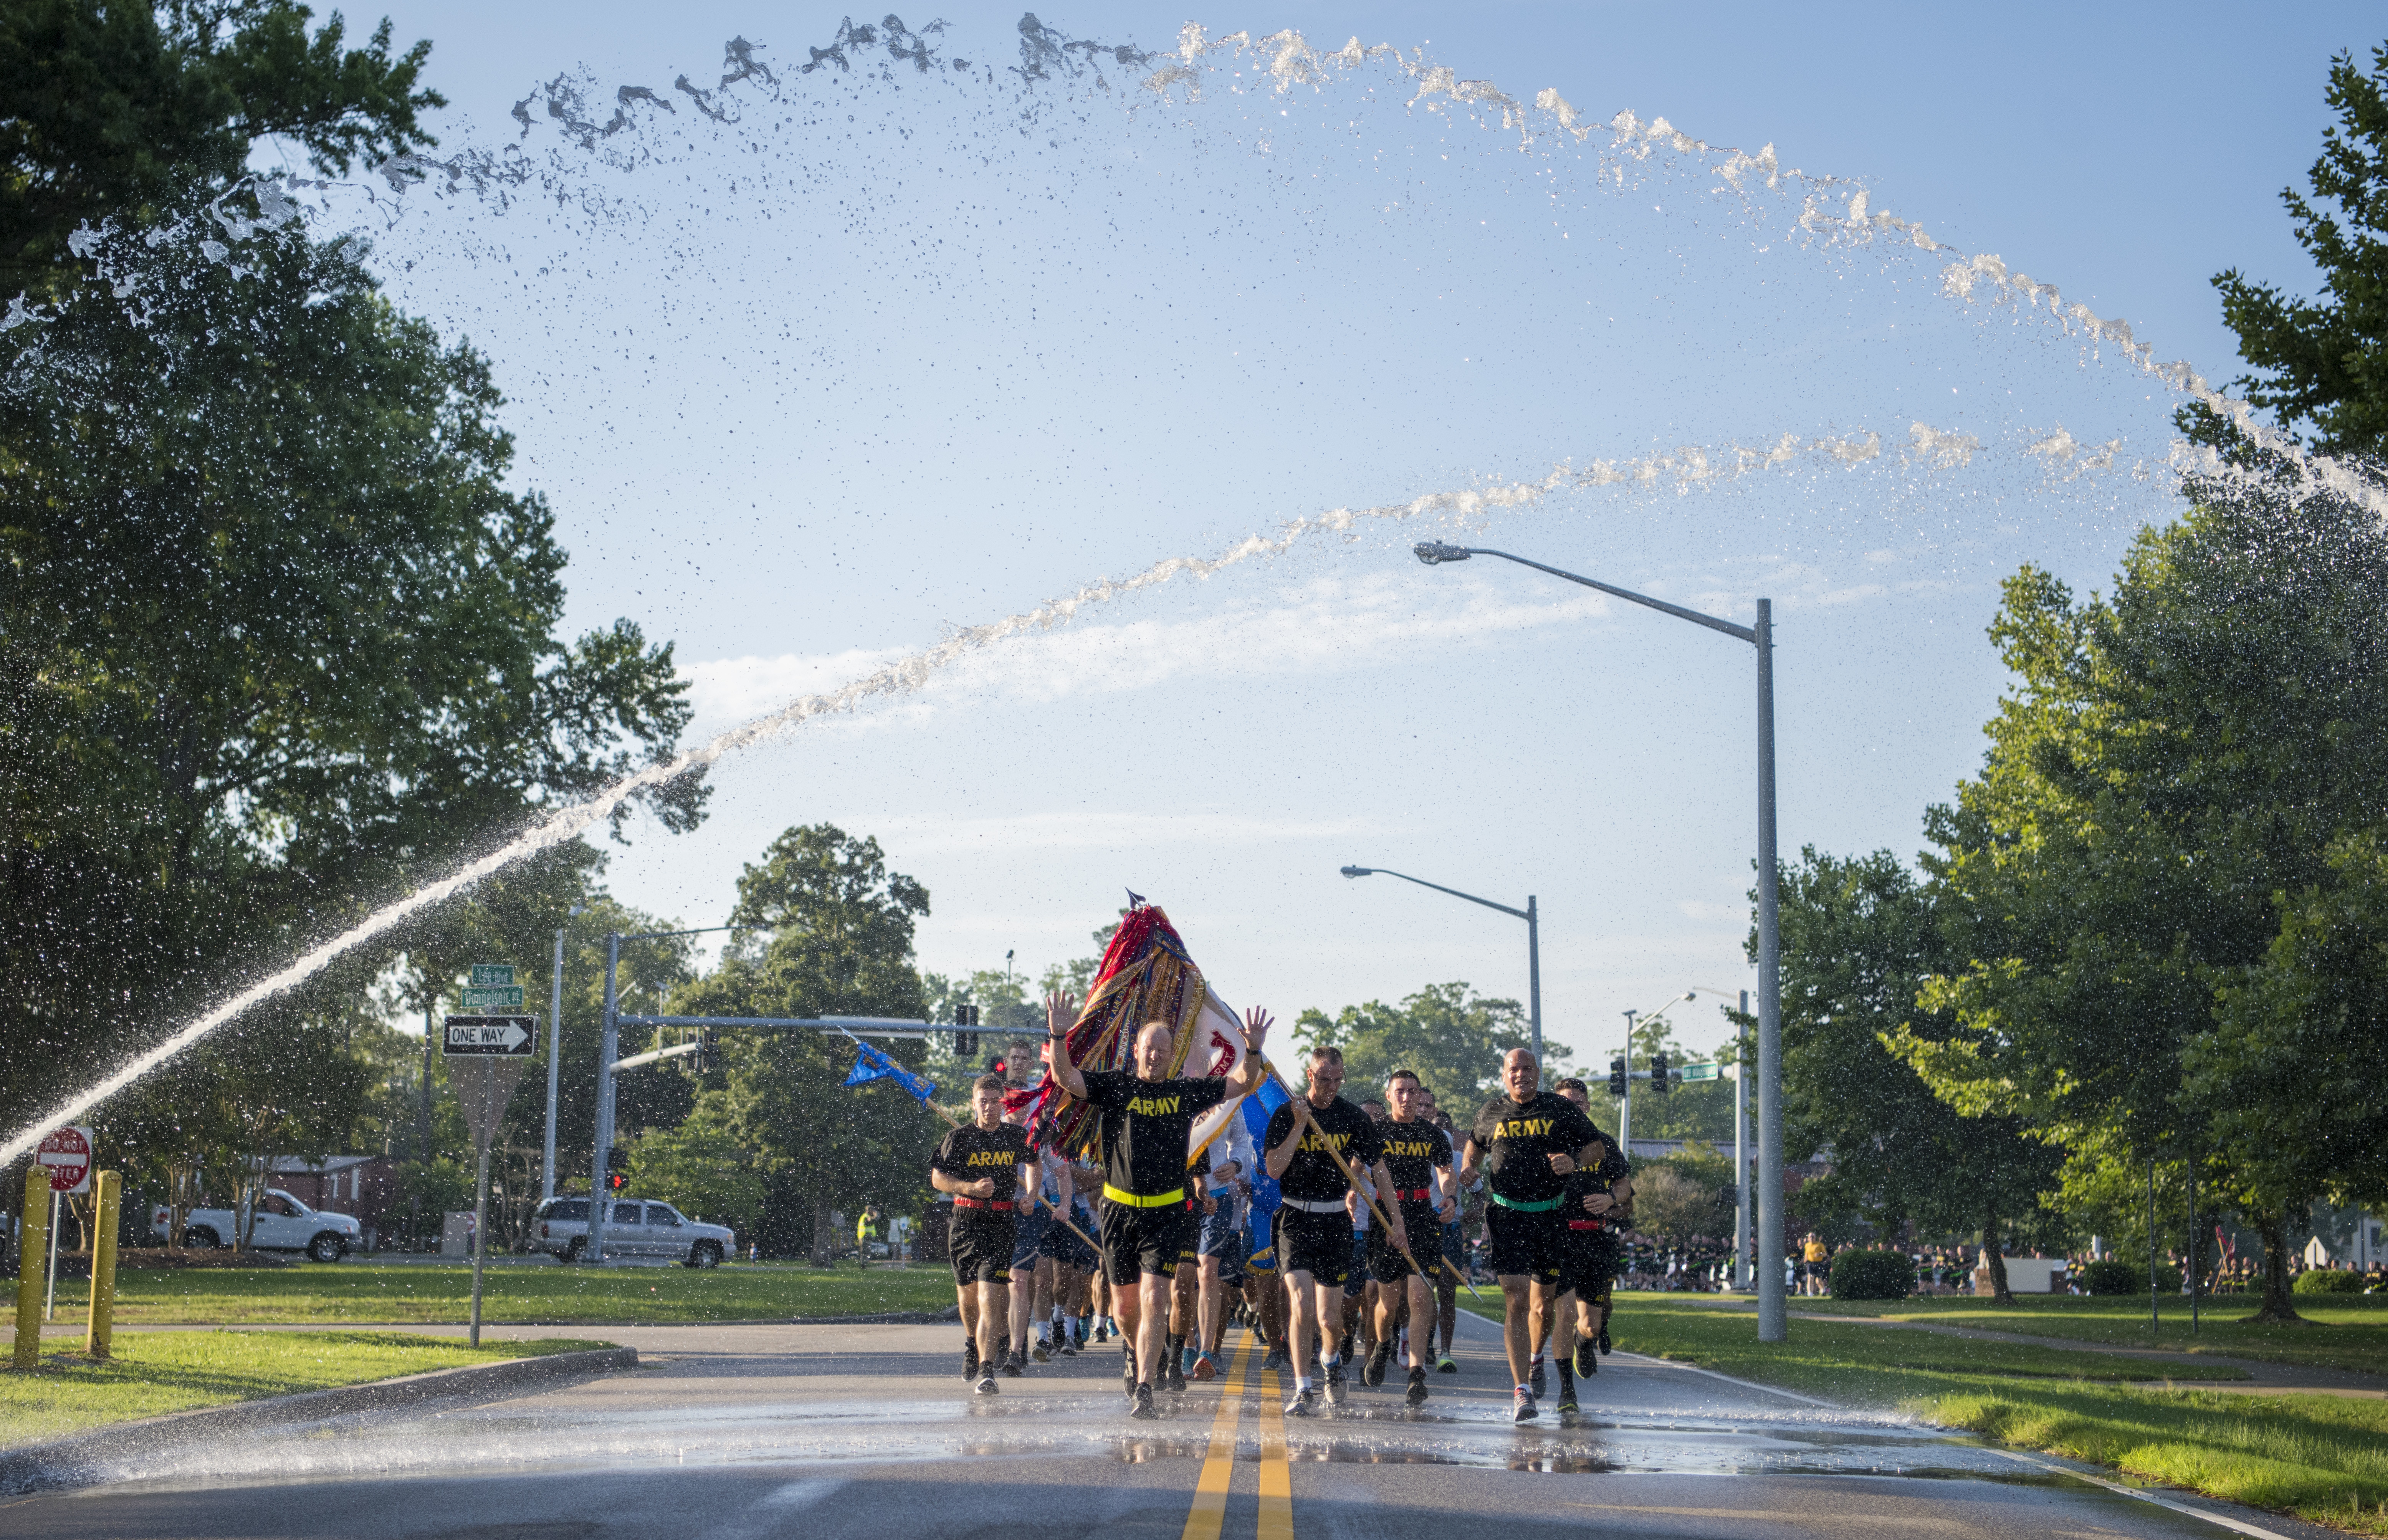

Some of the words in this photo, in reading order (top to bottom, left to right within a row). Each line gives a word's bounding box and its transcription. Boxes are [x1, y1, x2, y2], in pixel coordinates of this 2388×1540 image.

[452, 1028, 476, 1043] ONE
[481, 1028, 506, 1043] WAY
[1214, 1051, 1233, 1076] RMY
[1126, 1096, 1180, 1117] ARMY
[1493, 1119, 1554, 1140] ARMY
[45, 1139, 58, 1150] DO
[63, 1140, 83, 1151] NOT
[1296, 1133, 1351, 1151] ARMY
[1383, 1141, 1432, 1157] ARMY
[967, 1151, 1015, 1167] ARMY
[51, 1167, 79, 1180] NTER
[1163, 1262, 1176, 1273] ARM
[1429, 1265, 1440, 1275] ARM
